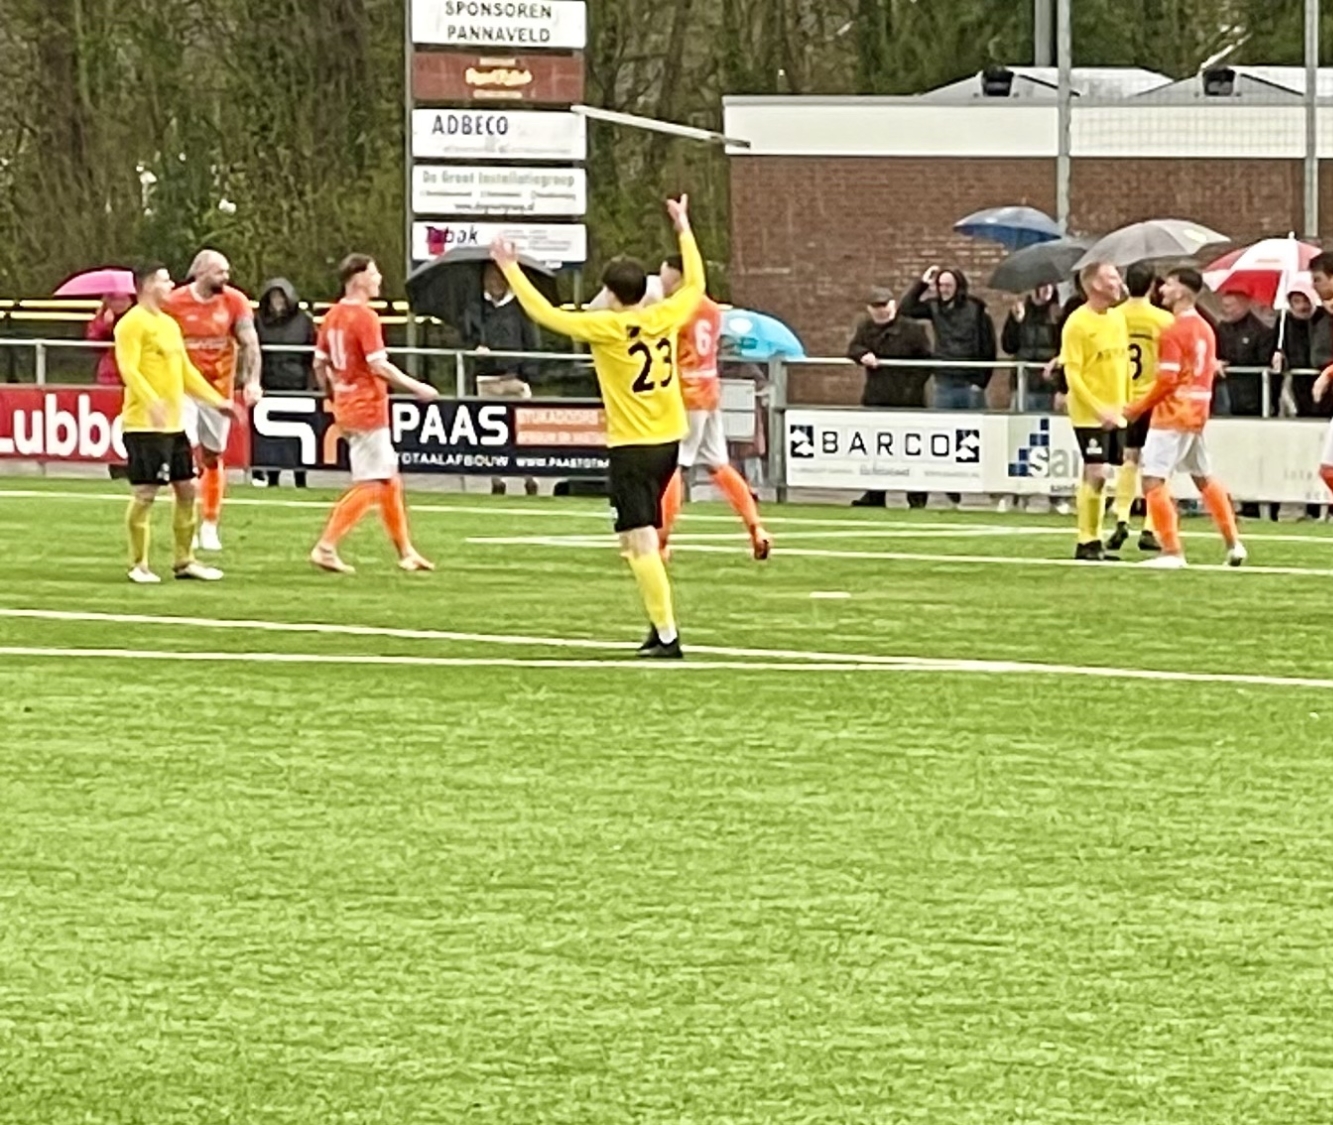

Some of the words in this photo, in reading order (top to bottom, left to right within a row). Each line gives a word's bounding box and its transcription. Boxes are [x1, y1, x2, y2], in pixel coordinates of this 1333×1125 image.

[445, 1, 552, 18] SPONSOREN
[447, 25, 550, 42] PANNAVELD
[431, 114, 509, 136] ADBECO
[694, 318, 713, 357] 6
[627, 337, 673, 393] 23
[391, 401, 509, 446] PAAS
[821, 430, 951, 458] BARCO
